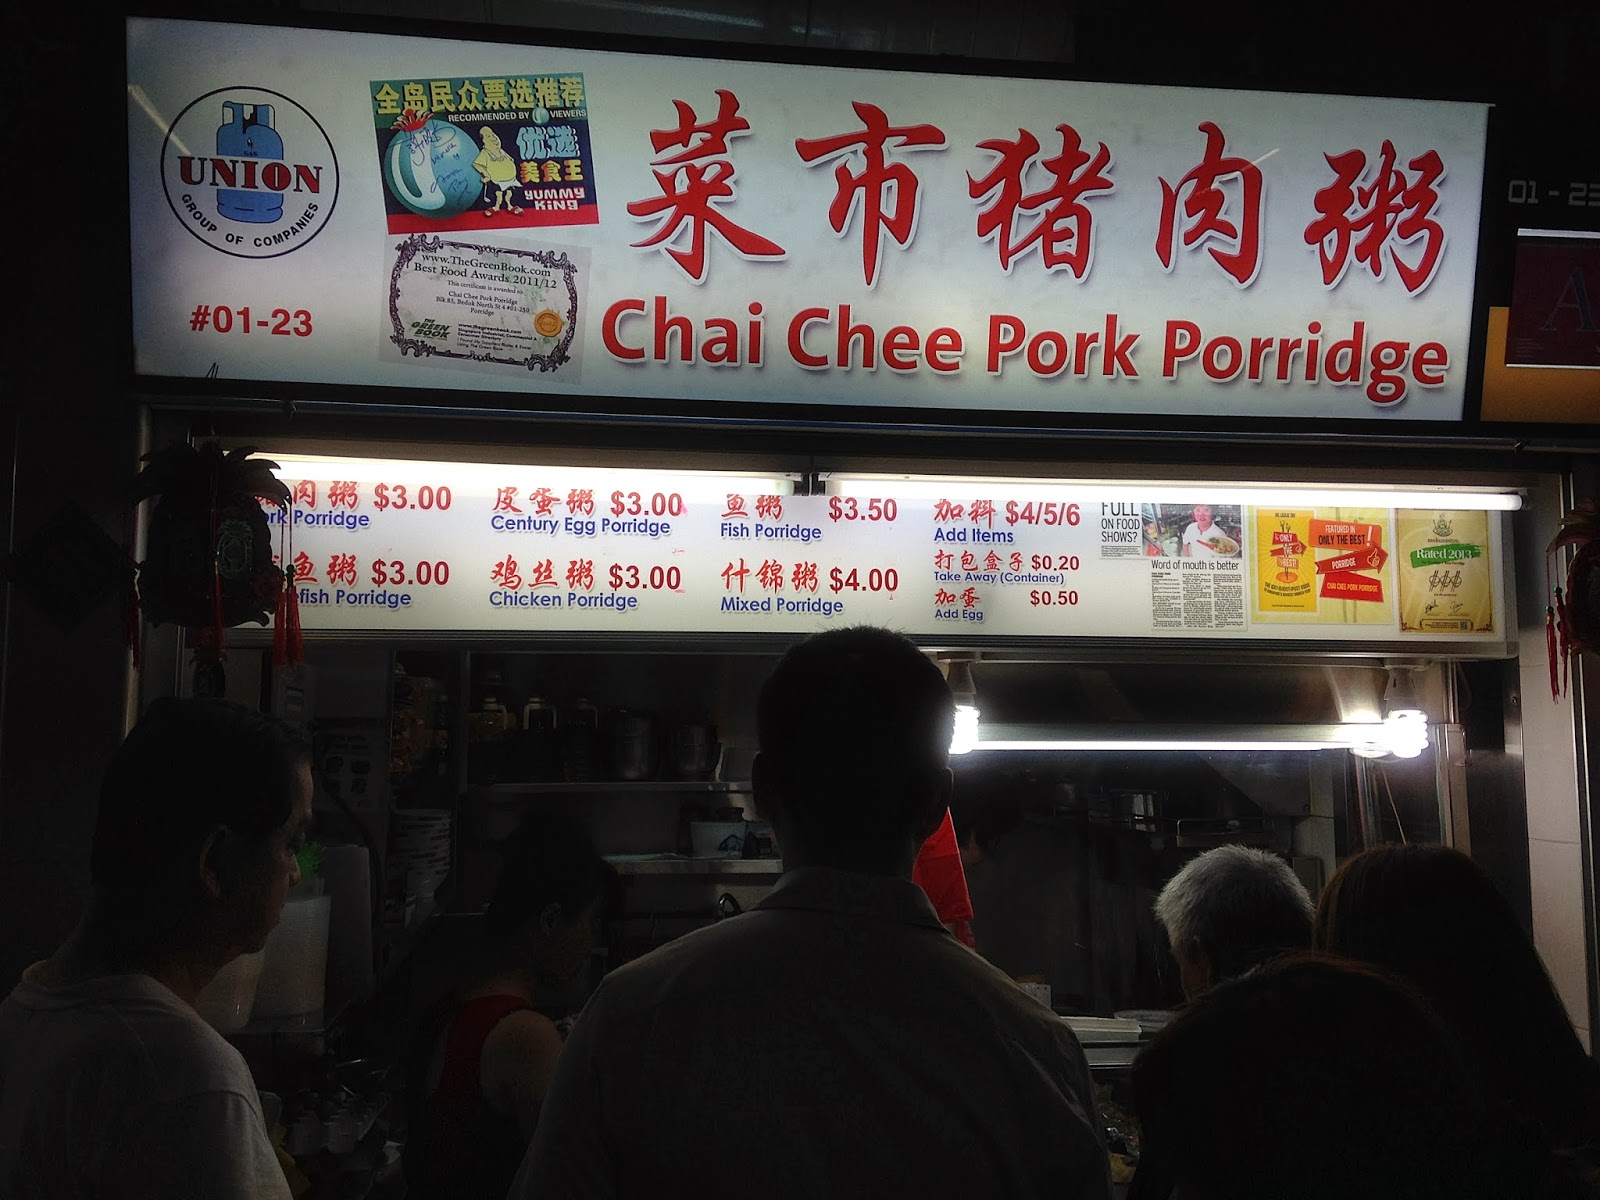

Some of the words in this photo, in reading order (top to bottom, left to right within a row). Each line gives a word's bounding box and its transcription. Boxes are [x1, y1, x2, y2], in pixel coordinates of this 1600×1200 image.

[375, 77, 584, 114] 全岛民众票选推荐
[448, 112, 517, 122] RECOMMENDED
[518, 111, 530, 119] BY
[550, 109, 587, 118] VIEWERS
[516, 125, 580, 159] 优选
[177, 156, 322, 194] UNION
[520, 159, 583, 183] 美食王
[627, 89, 1445, 293] 菜市猪肉粥
[181, 194, 218, 233] GROUP
[225, 233, 244, 245] OF
[254, 202, 319, 247] COMPANIES
[414, 262, 437, 274] Best
[440, 266, 467, 278] Food
[471, 269, 510, 283] Awards
[513, 275, 557, 289] 2011/12
[421, 254, 551, 277] www.TheGreenBook.com
[448, 291, 462, 299] Chai
[190, 305, 313, 337] #01-23
[411, 321, 450, 332] GREEN
[414, 328, 450, 338] BOOK
[601, 296, 763, 364] Chai
[787, 304, 963, 372] Chee
[986, 314, 1140, 375] Pork
[1162, 320, 1448, 404] Porridge
[373, 483, 451, 511] $3.00
[492, 487, 595, 516] 皮蛋粥
[611, 490, 682, 517] $3.00
[294, 509, 370, 529] Porridge
[829, 495, 898, 522] $3.50
[934, 499, 996, 529] 加料
[1005, 500, 1080, 526] $4/5/6
[491, 515, 559, 534] Century
[565, 517, 595, 536] Egg
[602, 518, 670, 537] Porridge
[721, 523, 749, 538] Fish
[755, 523, 822, 541] Porridge
[934, 527, 967, 542] Add
[972, 528, 1014, 543] Items
[1101, 518, 1114, 529] ON
[1116, 518, 1140, 530] FOOD
[1325, 525, 1349, 533] FEATURED
[1101, 531, 1138, 543] SHOWS?
[1318, 534, 1334, 545] ONLY
[1337, 534, 1347, 545] THE
[934, 549, 1023, 572] 打包盒子
[1031, 554, 1080, 571] $0.20
[1416, 548, 1447, 559] Rated
[1448, 549, 1473, 559] 2013
[371, 559, 450, 587] $3.00
[490, 554, 594, 590] 鸡丝粥
[1151, 560, 1171, 570] Word
[1173, 560, 1181, 570] of
[1182, 560, 1207, 570] mouth
[1209, 561, 1215, 570] is
[1216, 560, 1240, 571] better
[608, 563, 681, 591] $3.00
[829, 566, 899, 594] $4.00
[934, 571, 961, 581] Take
[964, 572, 997, 584] Away
[1000, 572, 1065, 585] (Container)
[336, 589, 411, 609] Porridge
[489, 591, 561, 607] Chicken
[568, 592, 638, 610] Porridge
[721, 597, 771, 612] Mixed
[776, 597, 844, 615] Porridge
[935, 587, 980, 608] 加蛋
[1030, 590, 1079, 607] $0.50
[934, 609, 959, 619] Add
[962, 610, 984, 621] Egg
